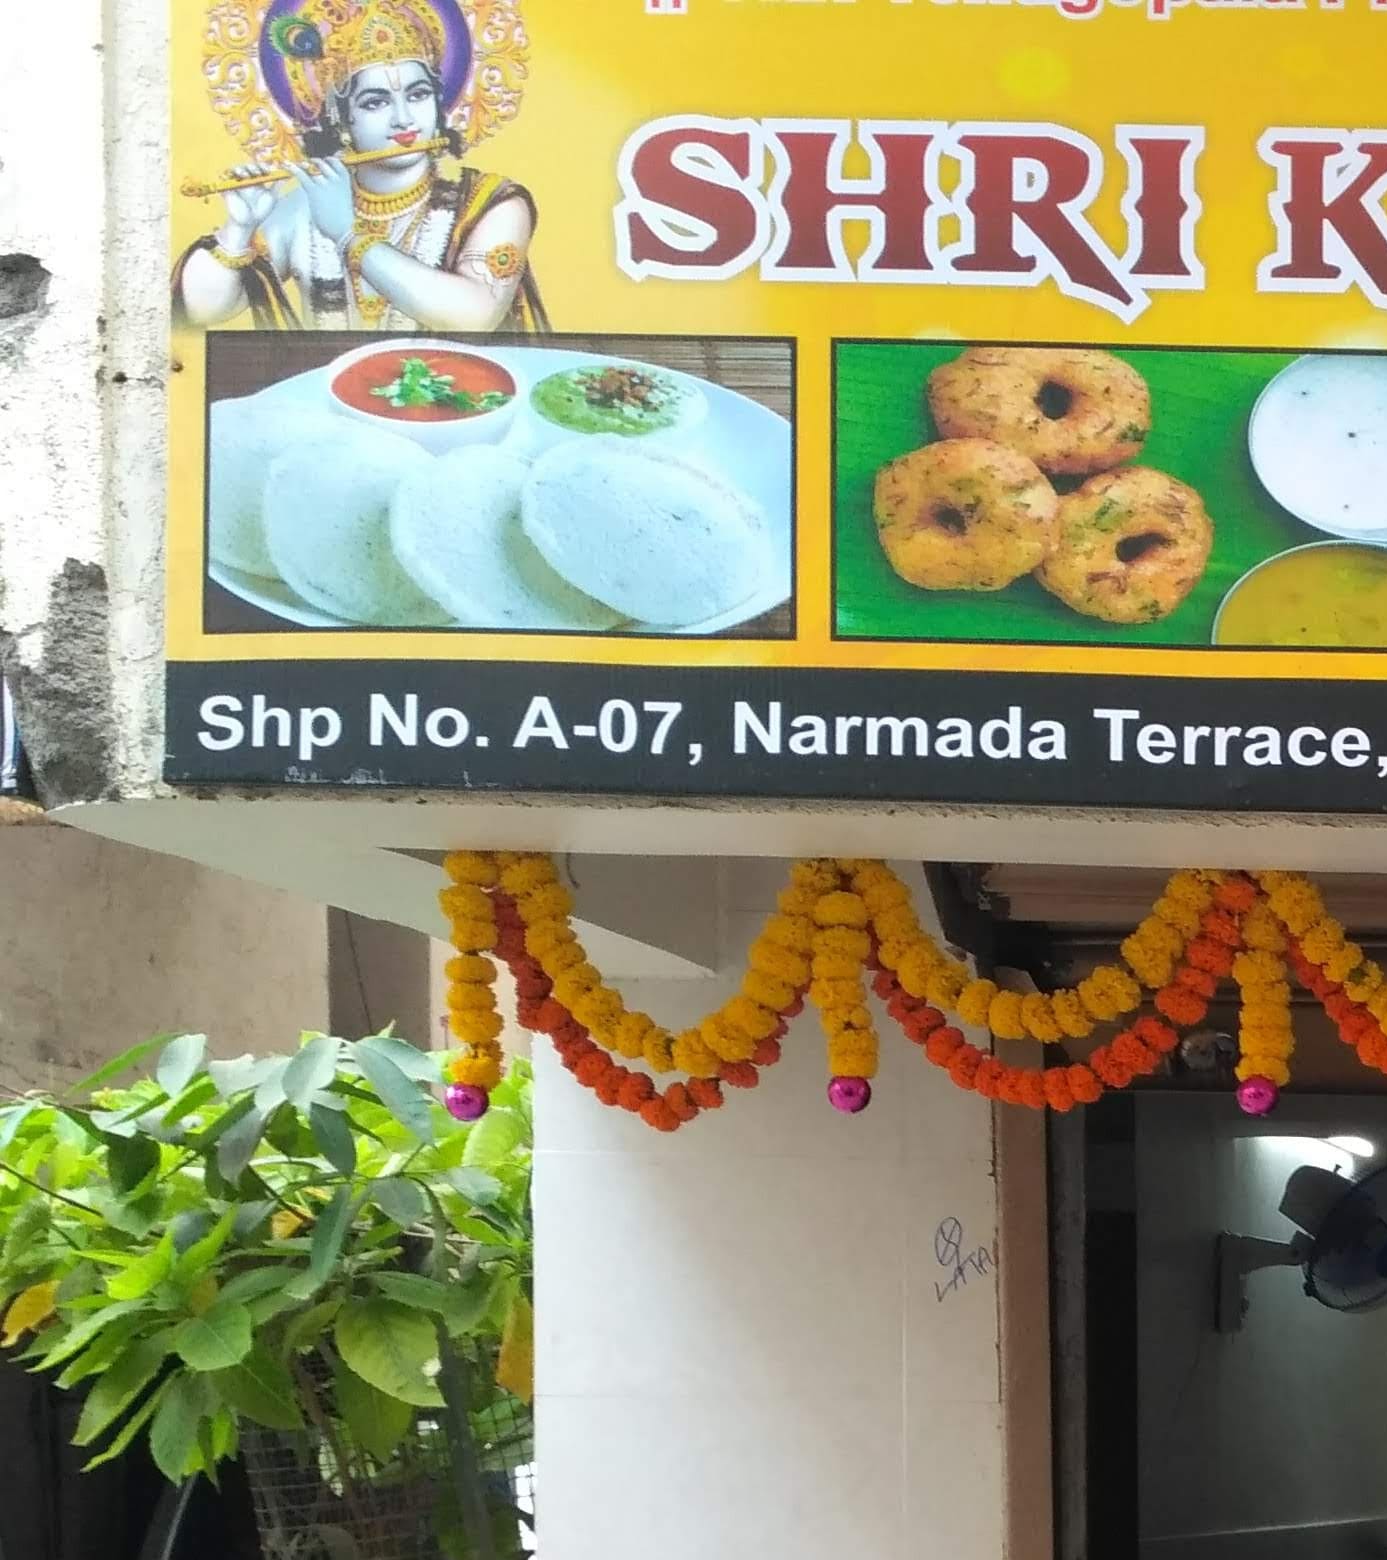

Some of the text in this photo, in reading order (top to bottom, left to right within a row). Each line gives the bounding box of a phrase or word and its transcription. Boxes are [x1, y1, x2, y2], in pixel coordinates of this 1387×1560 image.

[613, 114, 1205, 324] SHRI
[197, 693, 343, 762] Shp
[369, 692, 490, 748] No.
[511, 695, 703, 766] A-07,
[733, 700, 1067, 761] Narmada
